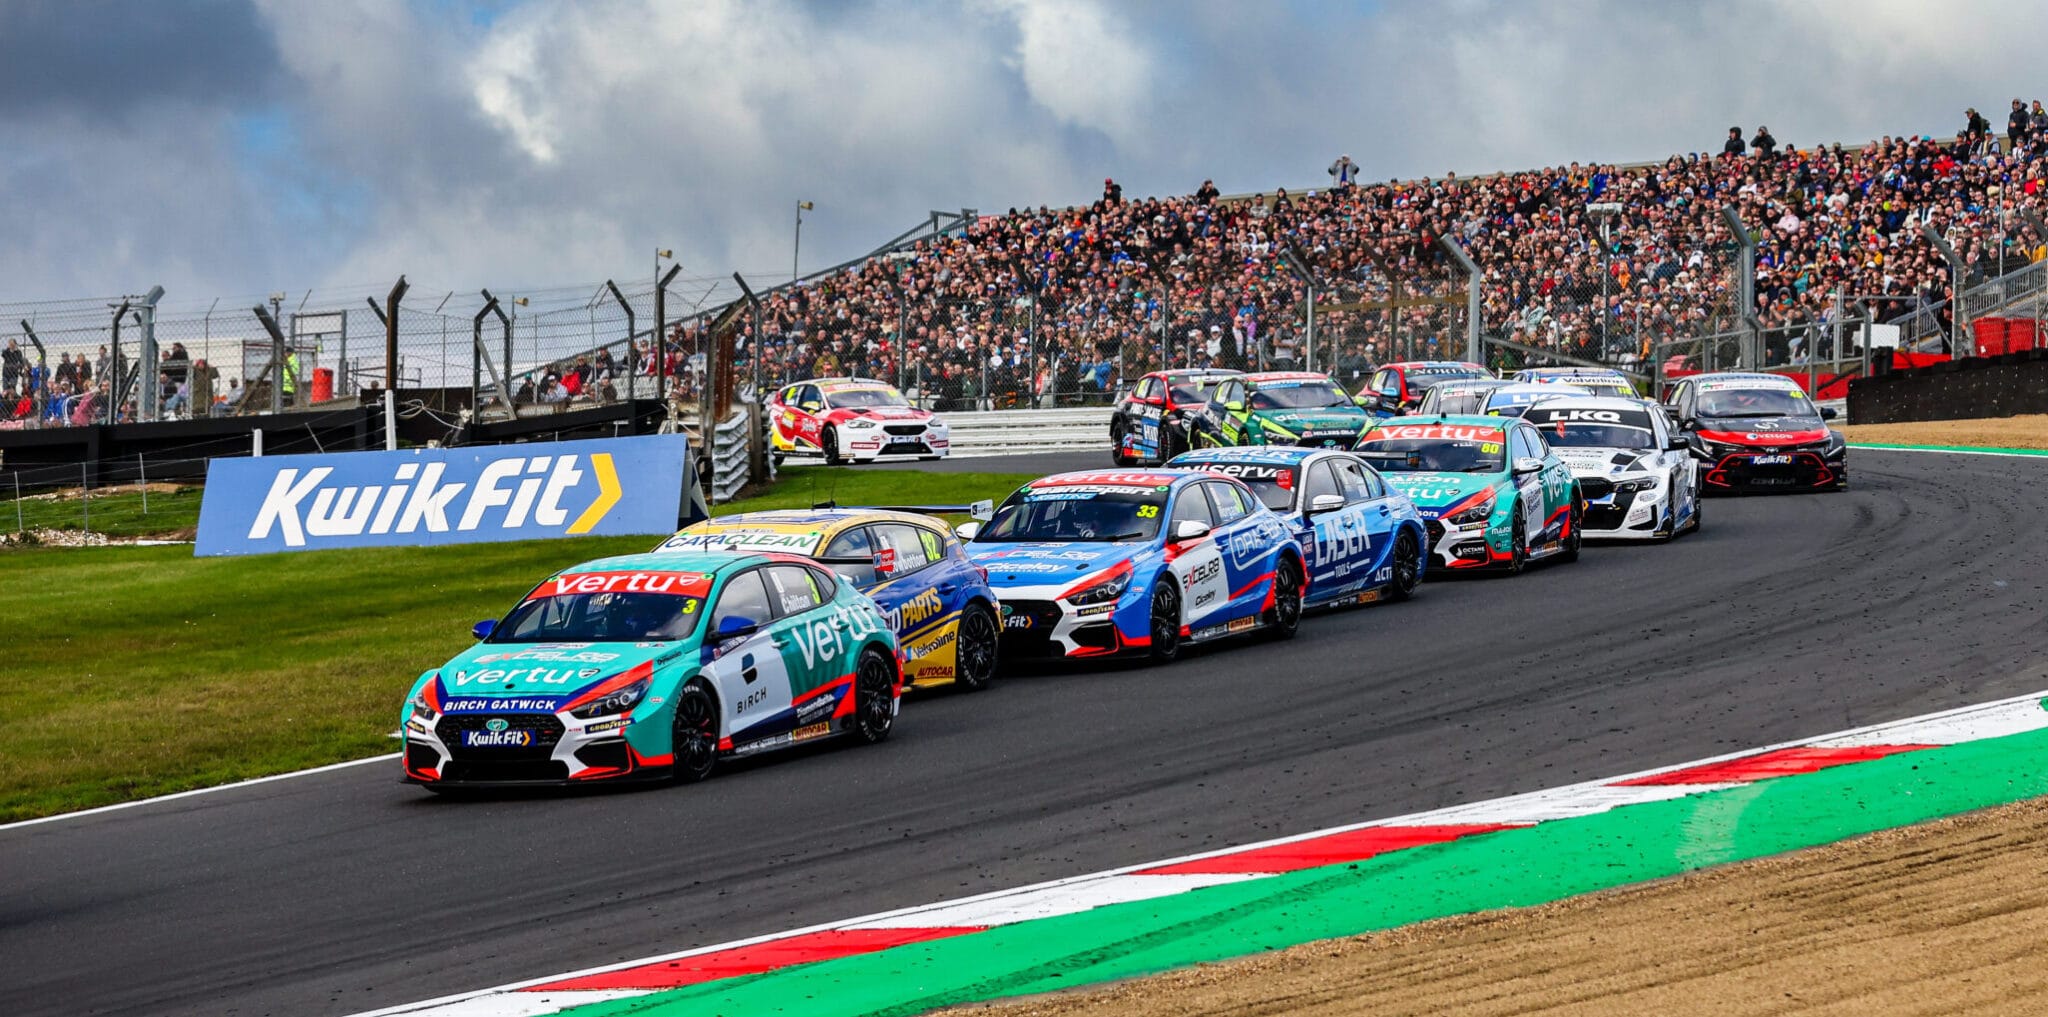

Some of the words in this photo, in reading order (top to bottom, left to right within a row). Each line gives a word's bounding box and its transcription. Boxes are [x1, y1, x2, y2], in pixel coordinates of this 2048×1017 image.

[1550, 411, 1621, 423] LKQ
[1380, 426, 1476, 440] vertu
[1481, 443, 1499, 454] 80
[1753, 455, 1788, 464] KwikFit
[248, 454, 583, 546] KwikFit
[1136, 504, 1159, 518] 33
[665, 534, 815, 549] CATACLEAN
[921, 532, 941, 561] 32
[1314, 510, 1371, 568] LASER
[1335, 562, 1351, 579] TOOLS
[556, 573, 676, 594] vertu
[805, 574, 821, 604] 3
[682, 598, 698, 614] 3
[781, 593, 811, 614] Chilton
[901, 586, 942, 630] PARTS
[914, 630, 955, 658] Valvoline
[456, 667, 576, 687] vertu
[917, 666, 953, 677] AUTOCAR
[443, 700, 487, 711] BIRCH
[491, 700, 556, 710] GATWICK
[737, 686, 767, 714] BIRCH
[589, 719, 632, 732] GOODYEAR
[467, 731, 525, 746] KwikFit
